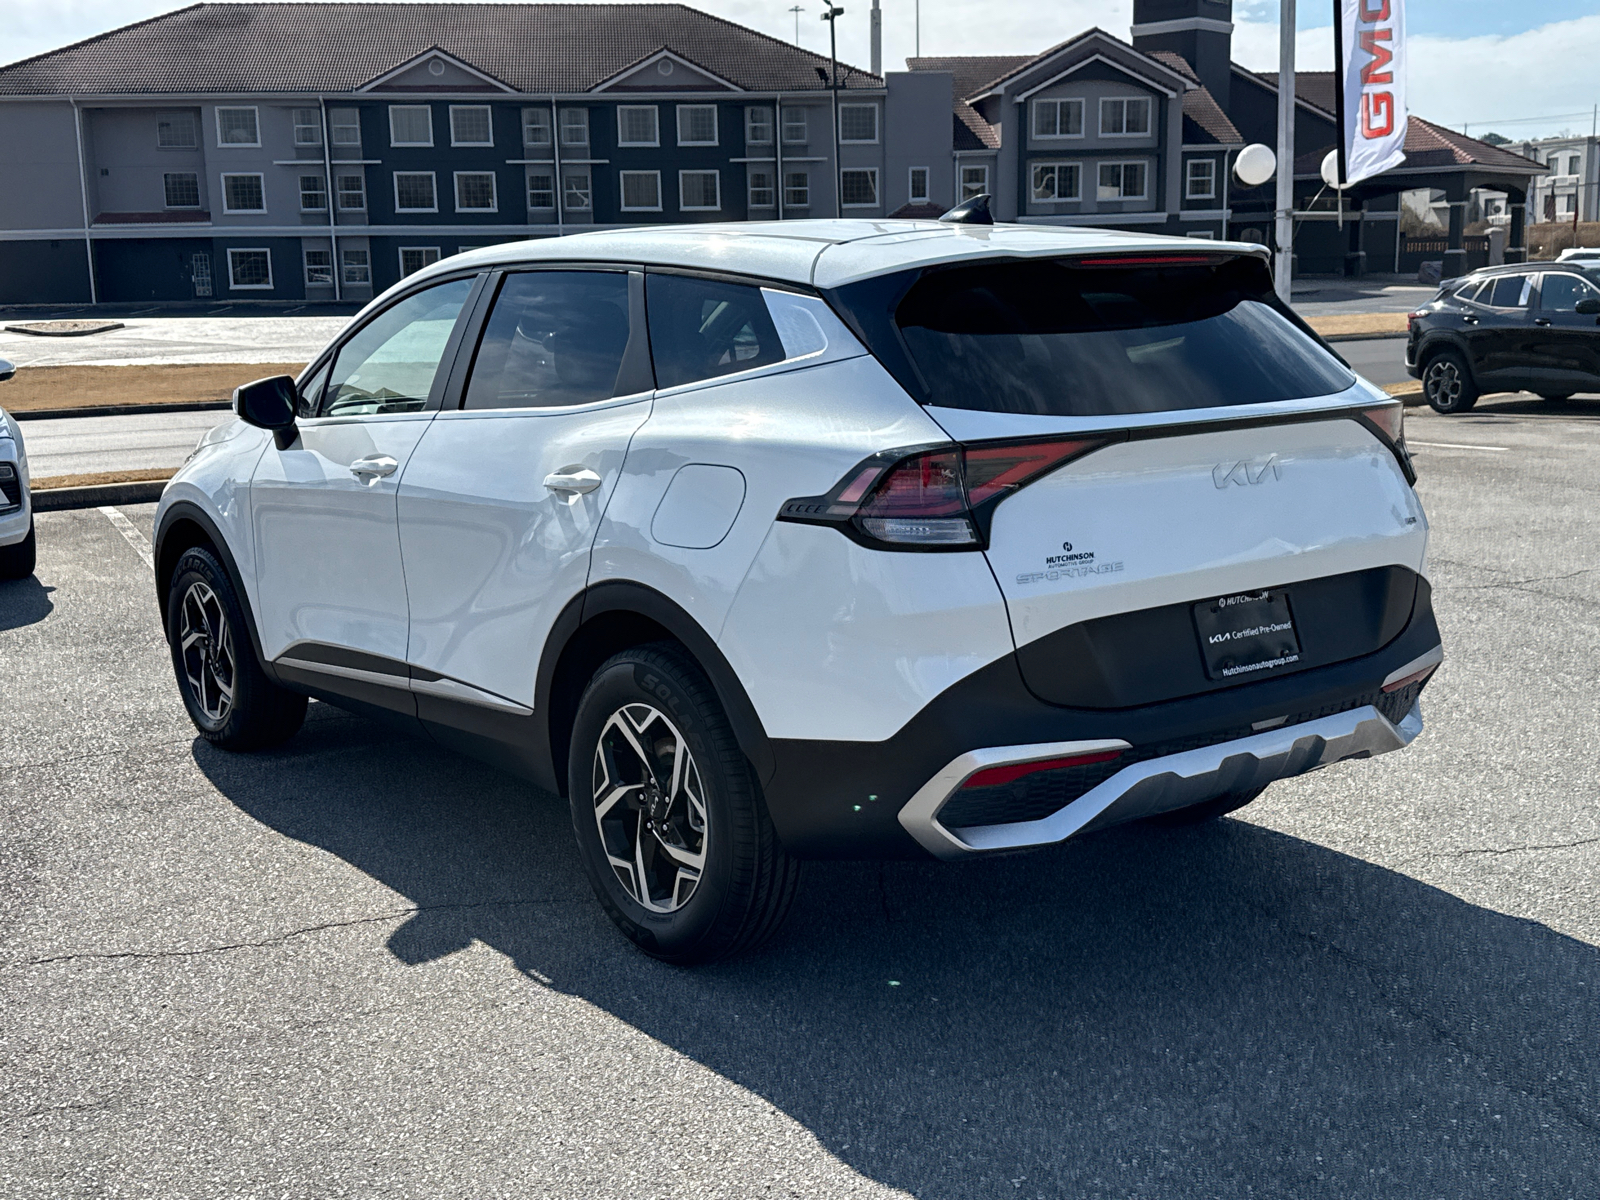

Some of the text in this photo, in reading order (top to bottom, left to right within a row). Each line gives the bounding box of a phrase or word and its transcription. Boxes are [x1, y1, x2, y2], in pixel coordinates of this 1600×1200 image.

[1211, 453, 1282, 489] KIA
[1046, 551, 1095, 564] HUTCHINSON
[1048, 561, 1078, 569] AUTOMOTIVE
[1016, 561, 1124, 585] SPORTAGE
[1232, 627, 1260, 640] Certified
[1260, 620, 1292, 634] Pre-Owned
[1222, 655, 1299, 677] Hutchinsonautogroup.com
